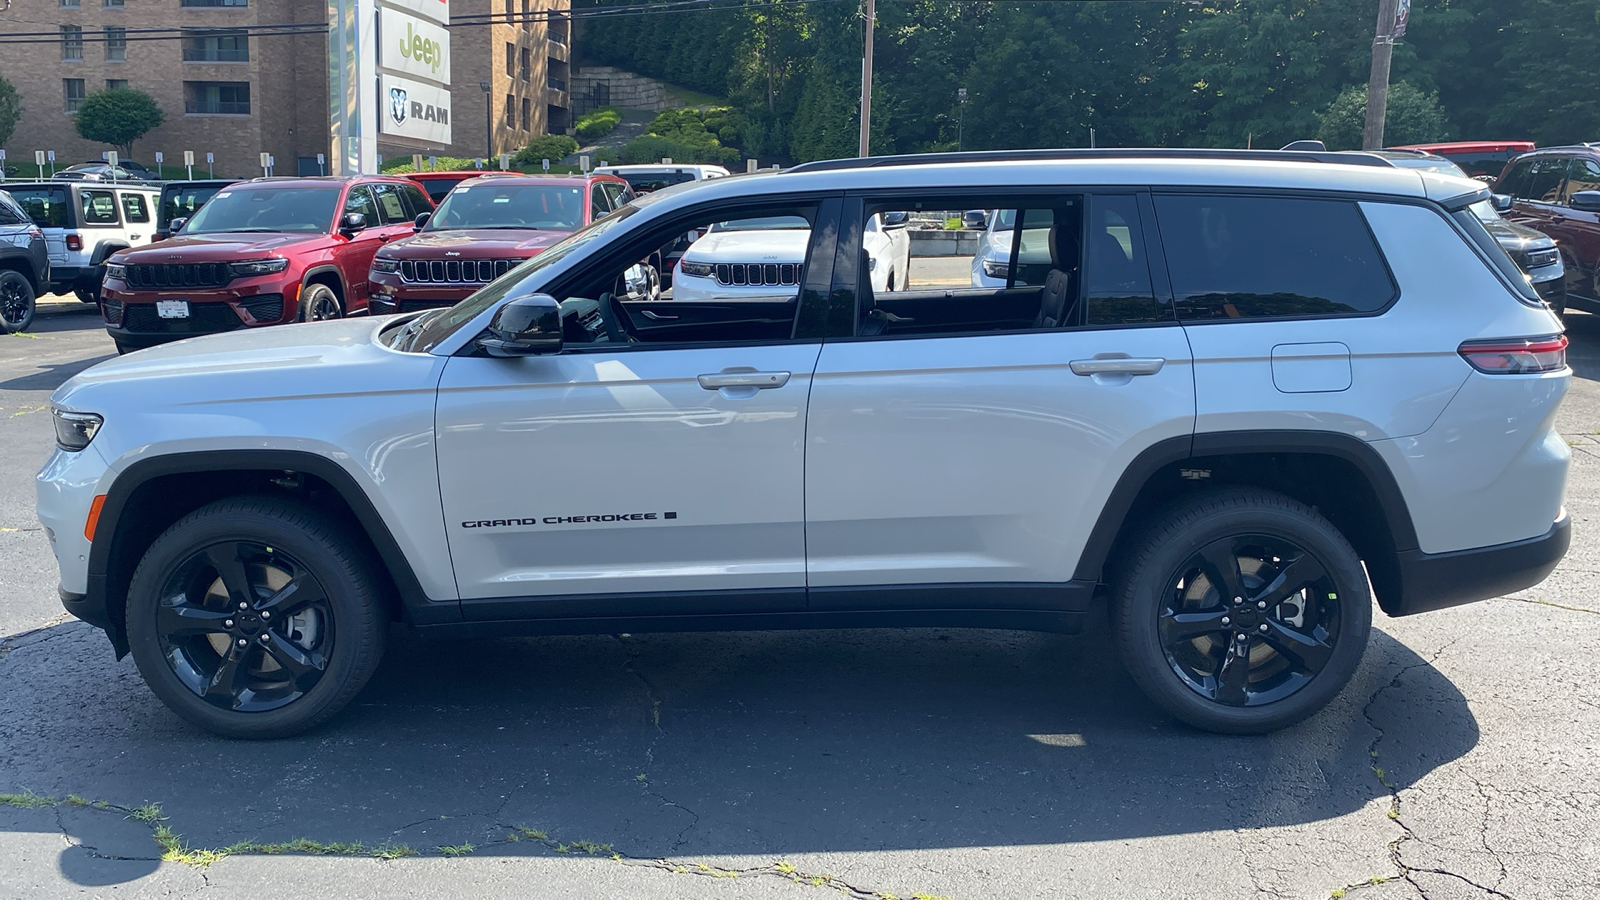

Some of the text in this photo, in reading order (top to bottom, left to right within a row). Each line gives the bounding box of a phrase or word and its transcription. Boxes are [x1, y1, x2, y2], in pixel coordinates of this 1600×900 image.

[400, 22, 441, 73] Jeep
[411, 101, 448, 125] RAM
[461, 518, 536, 528] GRAND
[543, 512, 658, 524] CHEROKEE
